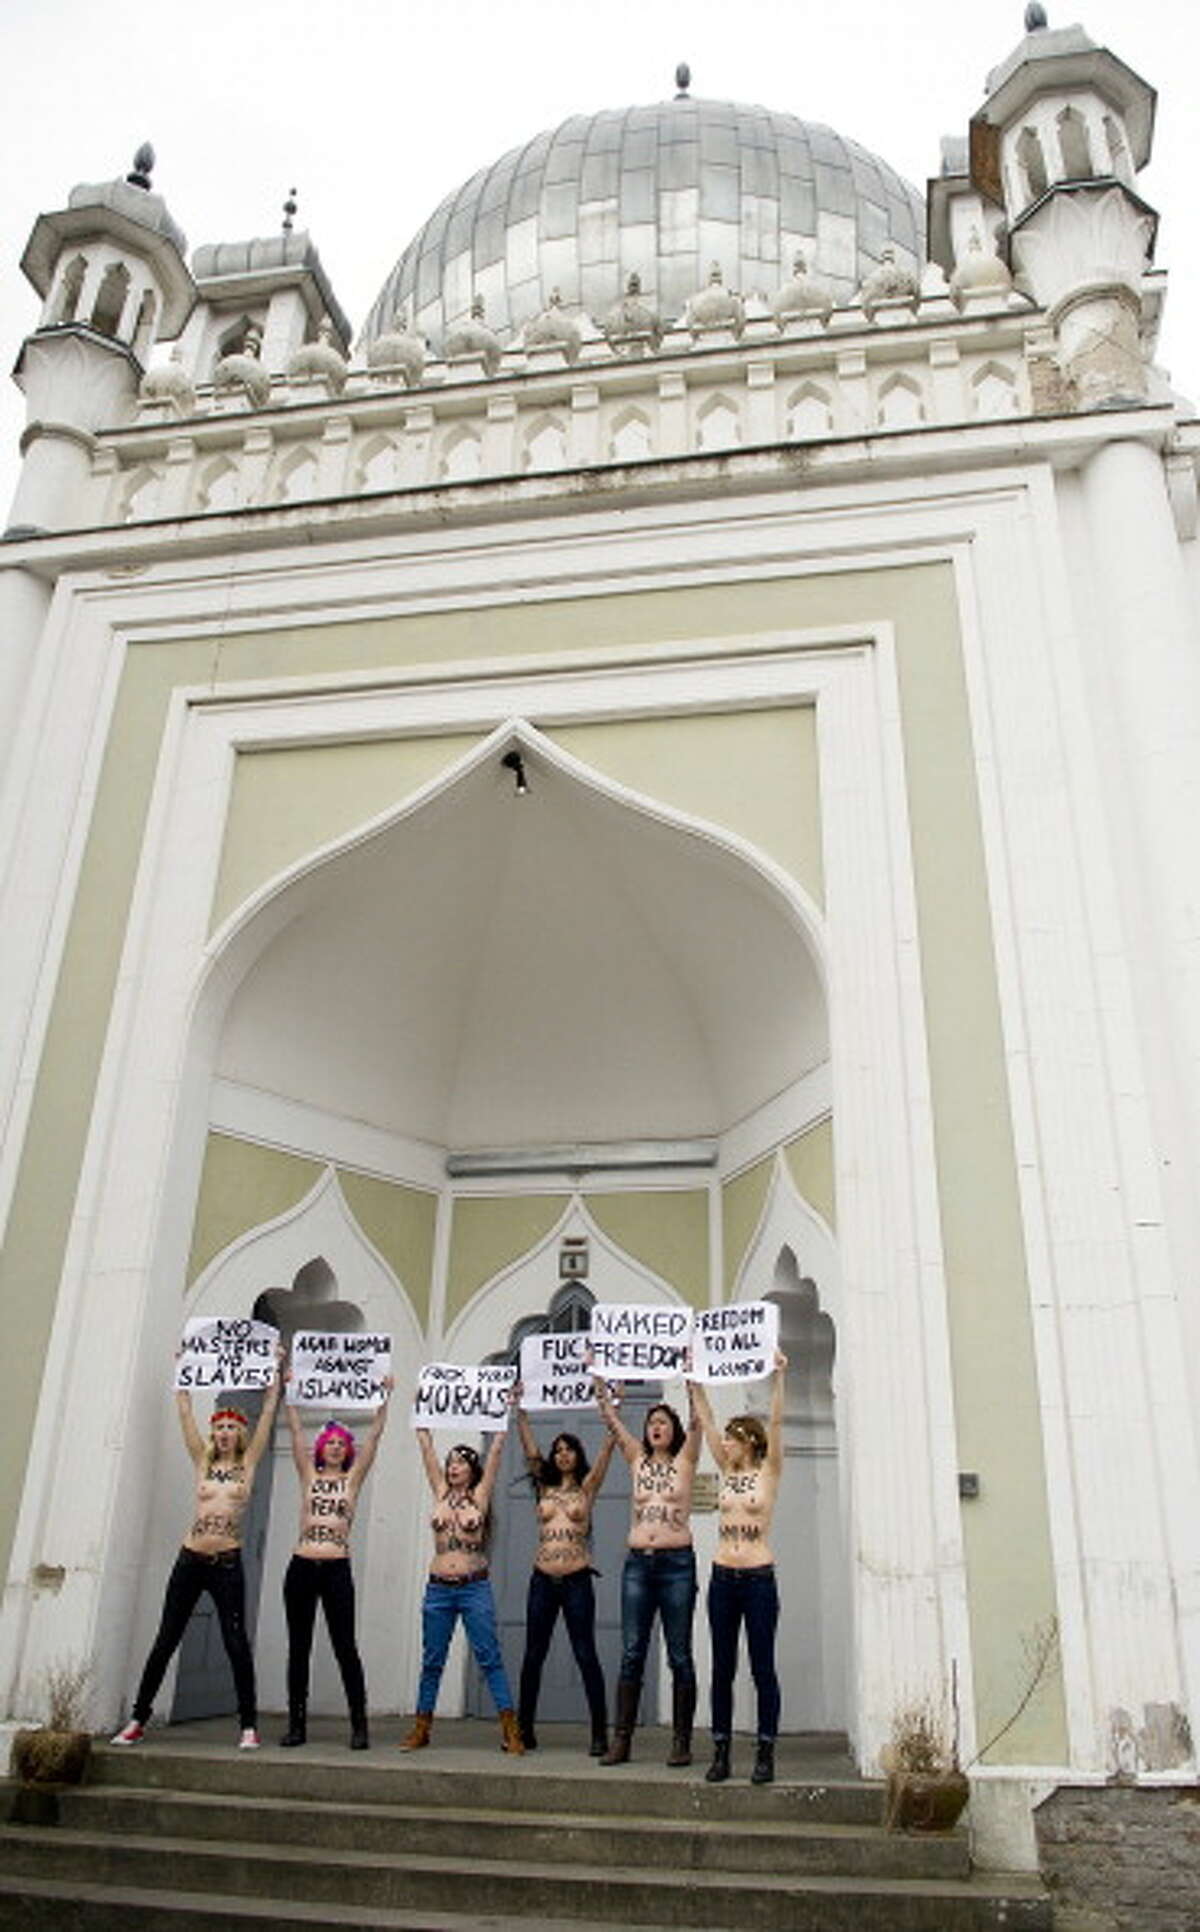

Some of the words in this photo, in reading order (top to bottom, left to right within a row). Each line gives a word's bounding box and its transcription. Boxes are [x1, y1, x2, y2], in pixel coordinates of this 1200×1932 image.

[216, 1319, 252, 1338] NO
[595, 1311, 687, 1335] NAKED
[704, 1336, 726, 1354] TO
[731, 1333, 761, 1350] ALL
[218, 1354, 243, 1368] NO
[592, 1342, 688, 1369] FREEDOM
[178, 1366, 272, 1387] SLAVES
[298, 1378, 385, 1399] ISLAMISM
[416, 1384, 508, 1419] MORALS
